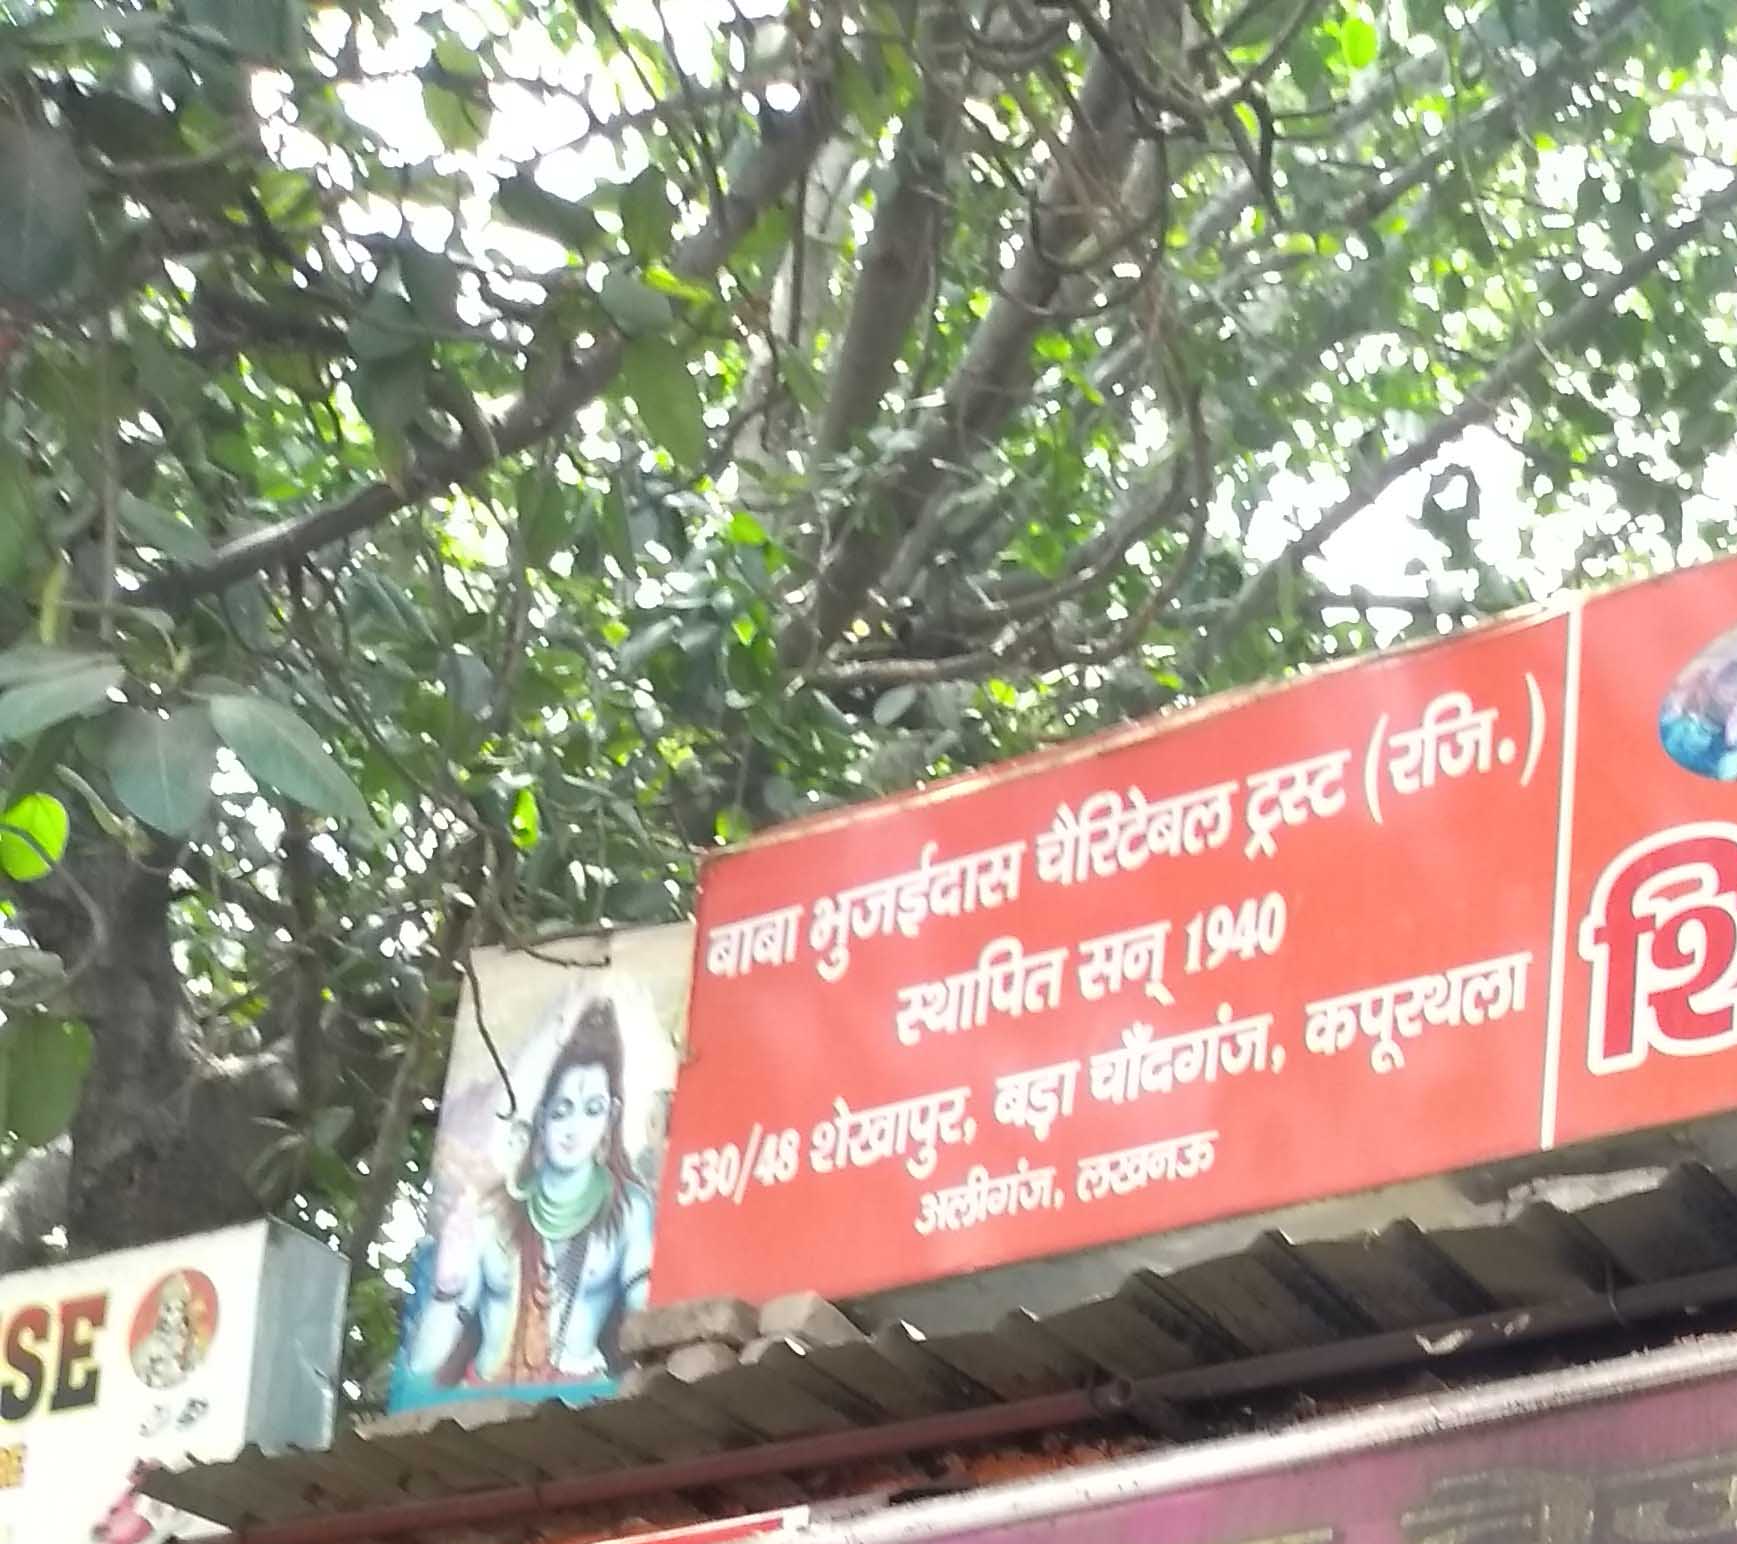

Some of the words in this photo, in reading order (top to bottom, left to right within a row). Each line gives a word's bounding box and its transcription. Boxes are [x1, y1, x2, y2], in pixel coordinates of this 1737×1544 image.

[706, 904, 803, 977] बाबा
[809, 842, 1026, 981] भुजईदास
[1035, 786, 1238, 886] चैरिटेबल
[1245, 750, 1351, 860] ट्रस्ट
[1364, 672, 1547, 824] (रजि.)
[896, 935, 1069, 1046] स्थापित
[1077, 920, 1174, 1006] सन्
[1183, 892, 1287, 974] 1940
[676, 1122, 800, 1206] 530/48
[914, 1157, 1065, 1236] अलीगंज,
[1076, 1130, 1219, 1202] लखनऊ
